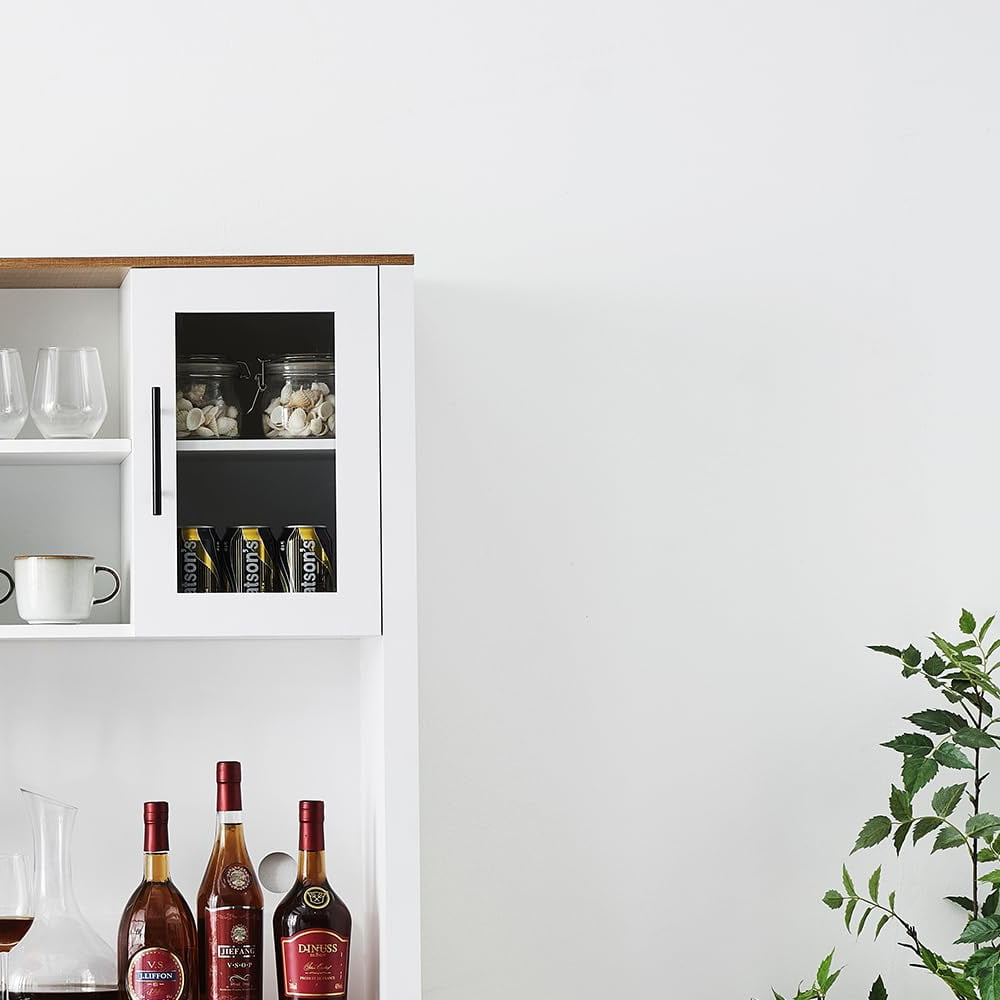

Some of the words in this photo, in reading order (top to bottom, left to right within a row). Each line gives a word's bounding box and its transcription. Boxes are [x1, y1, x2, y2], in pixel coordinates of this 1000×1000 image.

[181, 541, 197, 593] atson's
[243, 541, 259, 593] atson's
[300, 540, 316, 593] atson's
